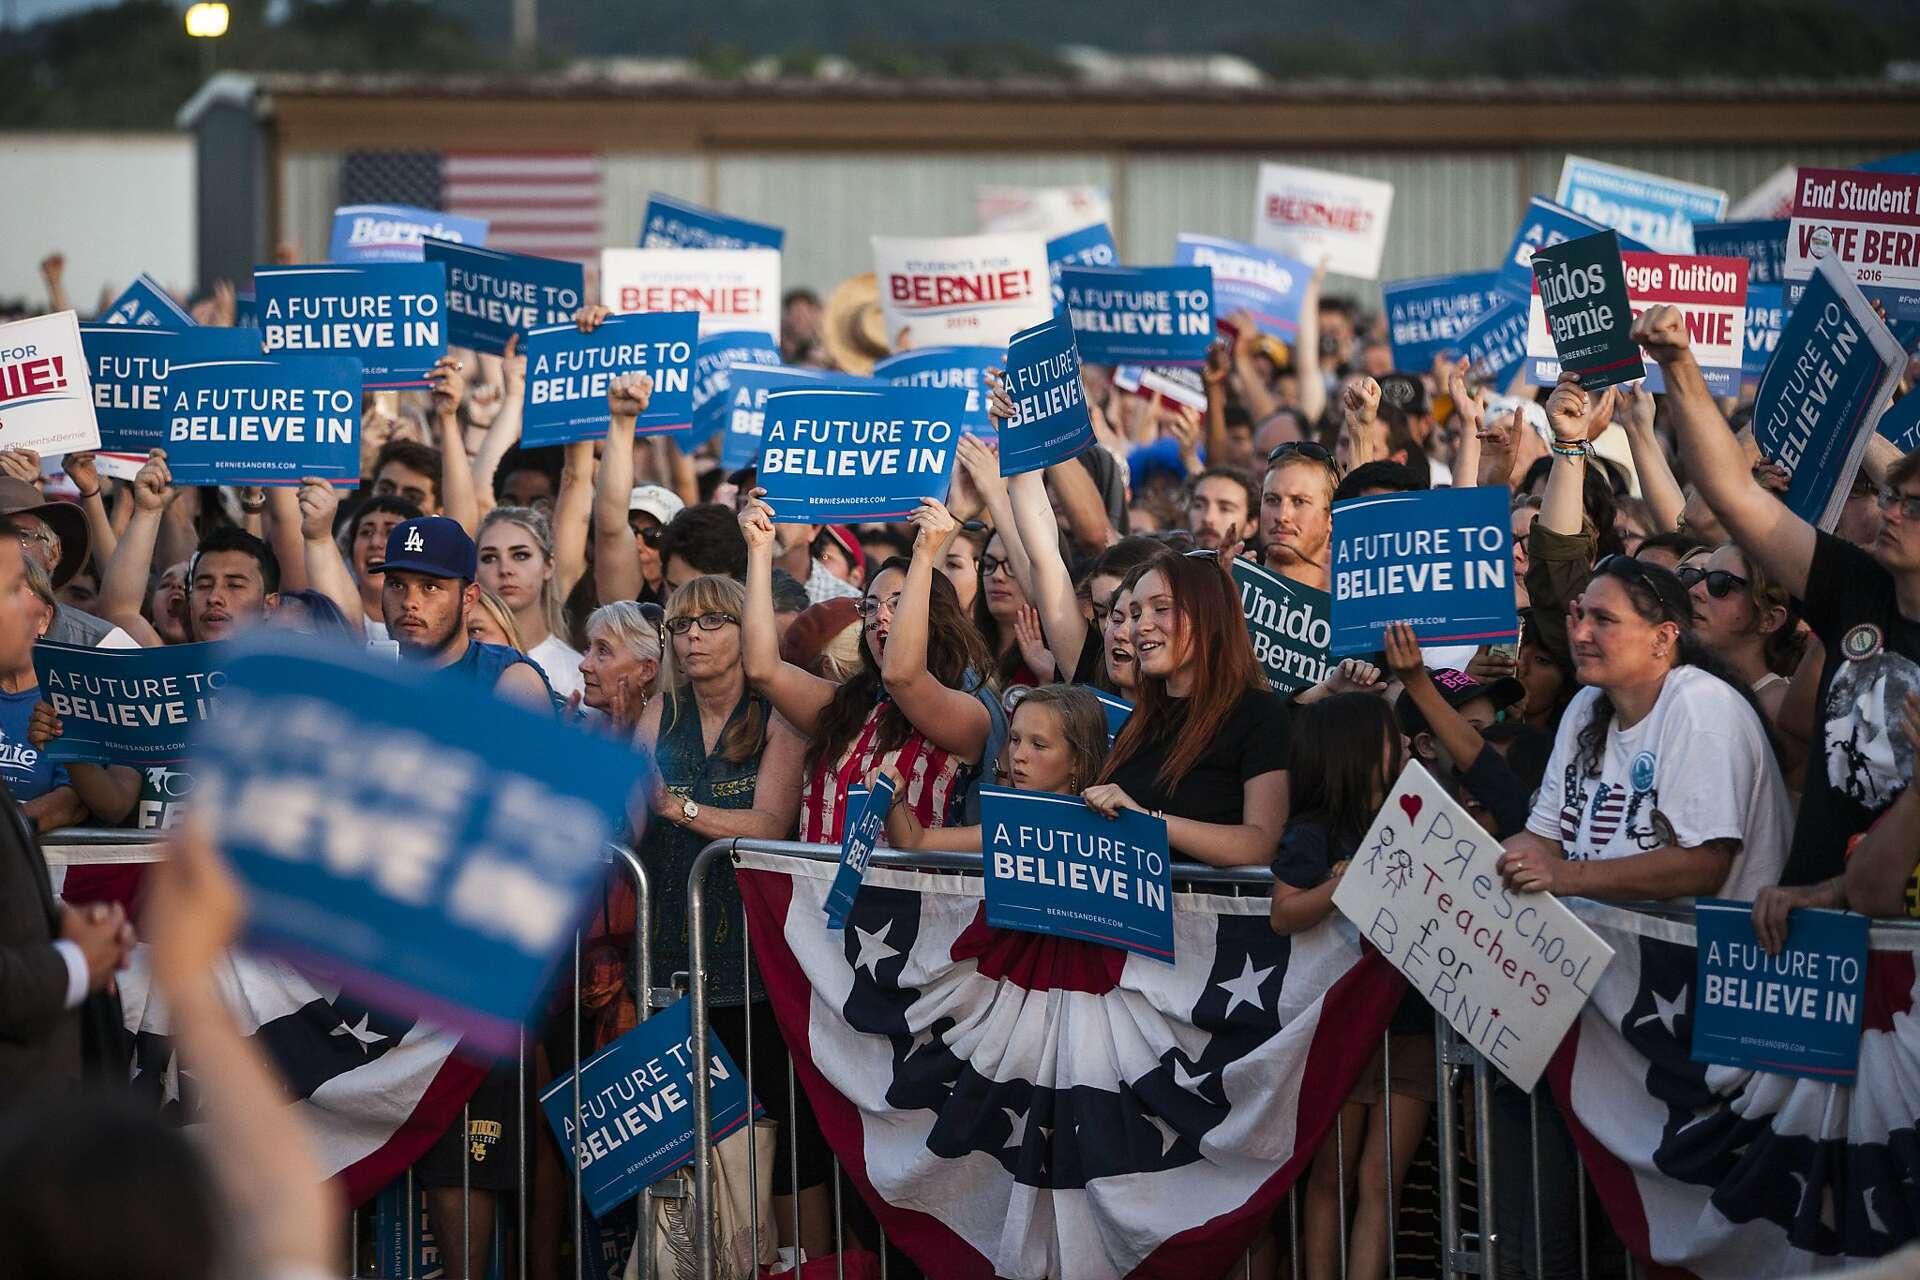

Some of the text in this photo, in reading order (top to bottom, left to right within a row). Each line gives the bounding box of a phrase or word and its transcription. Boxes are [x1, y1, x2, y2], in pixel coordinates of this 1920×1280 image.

[1802, 179, 1836, 208] End
[1839, 181, 1911, 215] Student
[1799, 224, 1858, 262] VTE
[451, 268, 578, 309] FUTURE TO
[890, 270, 1033, 305] BERNIE!
[1537, 261, 1607, 308] nidos
[1622, 260, 1664, 294] lege
[1669, 262, 1737, 294] Tuition
[1857, 269, 1882, 281] 2016
[266, 294, 438, 319] A FUTURE TO
[621, 287, 761, 314] BERNIE!
[1084, 289, 1170, 311] FUTURE
[1175, 289, 1209, 311] TO
[265, 321, 439, 349] BELIEVE IN
[1071, 309, 1210, 335] BELIEVE IN
[1, 345, 38, 361] FOR
[100, 356, 169, 379] FUTU
[534, 341, 690, 375] A FUTURE TO
[0, 356, 67, 402] IE!
[531, 370, 648, 405] BELIE
[655, 368, 688, 393] IN
[1005, 374, 1017, 394] A
[1018, 349, 1073, 392] FUTURE
[1763, 302, 1841, 458] A FUTURE TO
[95, 384, 168, 409] ELIE
[173, 389, 353, 413] A FUTURE TO
[1007, 378, 1079, 429] BELIEVE
[1775, 321, 1860, 478] BELIEVE IN
[169, 417, 353, 445] BELIEVE IN
[769, 420, 950, 443] A FUTURE TO
[215, 461, 297, 471] BERNIESANDERS.COM
[763, 447, 946, 476] BELIEVE IN
[809, 495, 886, 505] BERNIESANDERS.COM
[404, 526, 424, 552] LA
[1338, 526, 1504, 564] A FUTURE TO
[1336, 560, 1506, 600] BELIEVE IN
[1241, 581, 1331, 649] Unido
[48, 668, 228, 699] A FUTURE TO
[50, 691, 188, 727] BELIEVE
[138, 800, 186, 830] FE
[994, 823, 1163, 876] A FUTURE TO
[993, 852, 1165, 912] BELIEVE IN
[1047, 908, 1123, 928] BERNIESANDERS.COM
[1423, 863, 1551, 1006] Teachers
[1420, 918, 1473, 979] for
[1707, 940, 1859, 984] A FUTURE TO
[1704, 974, 1857, 1025] BELIEVE IN
[563, 1115, 578, 1140] A
[579, 1057, 668, 1129] FUTURE
[571, 1082, 688, 1170] BELIEVE
